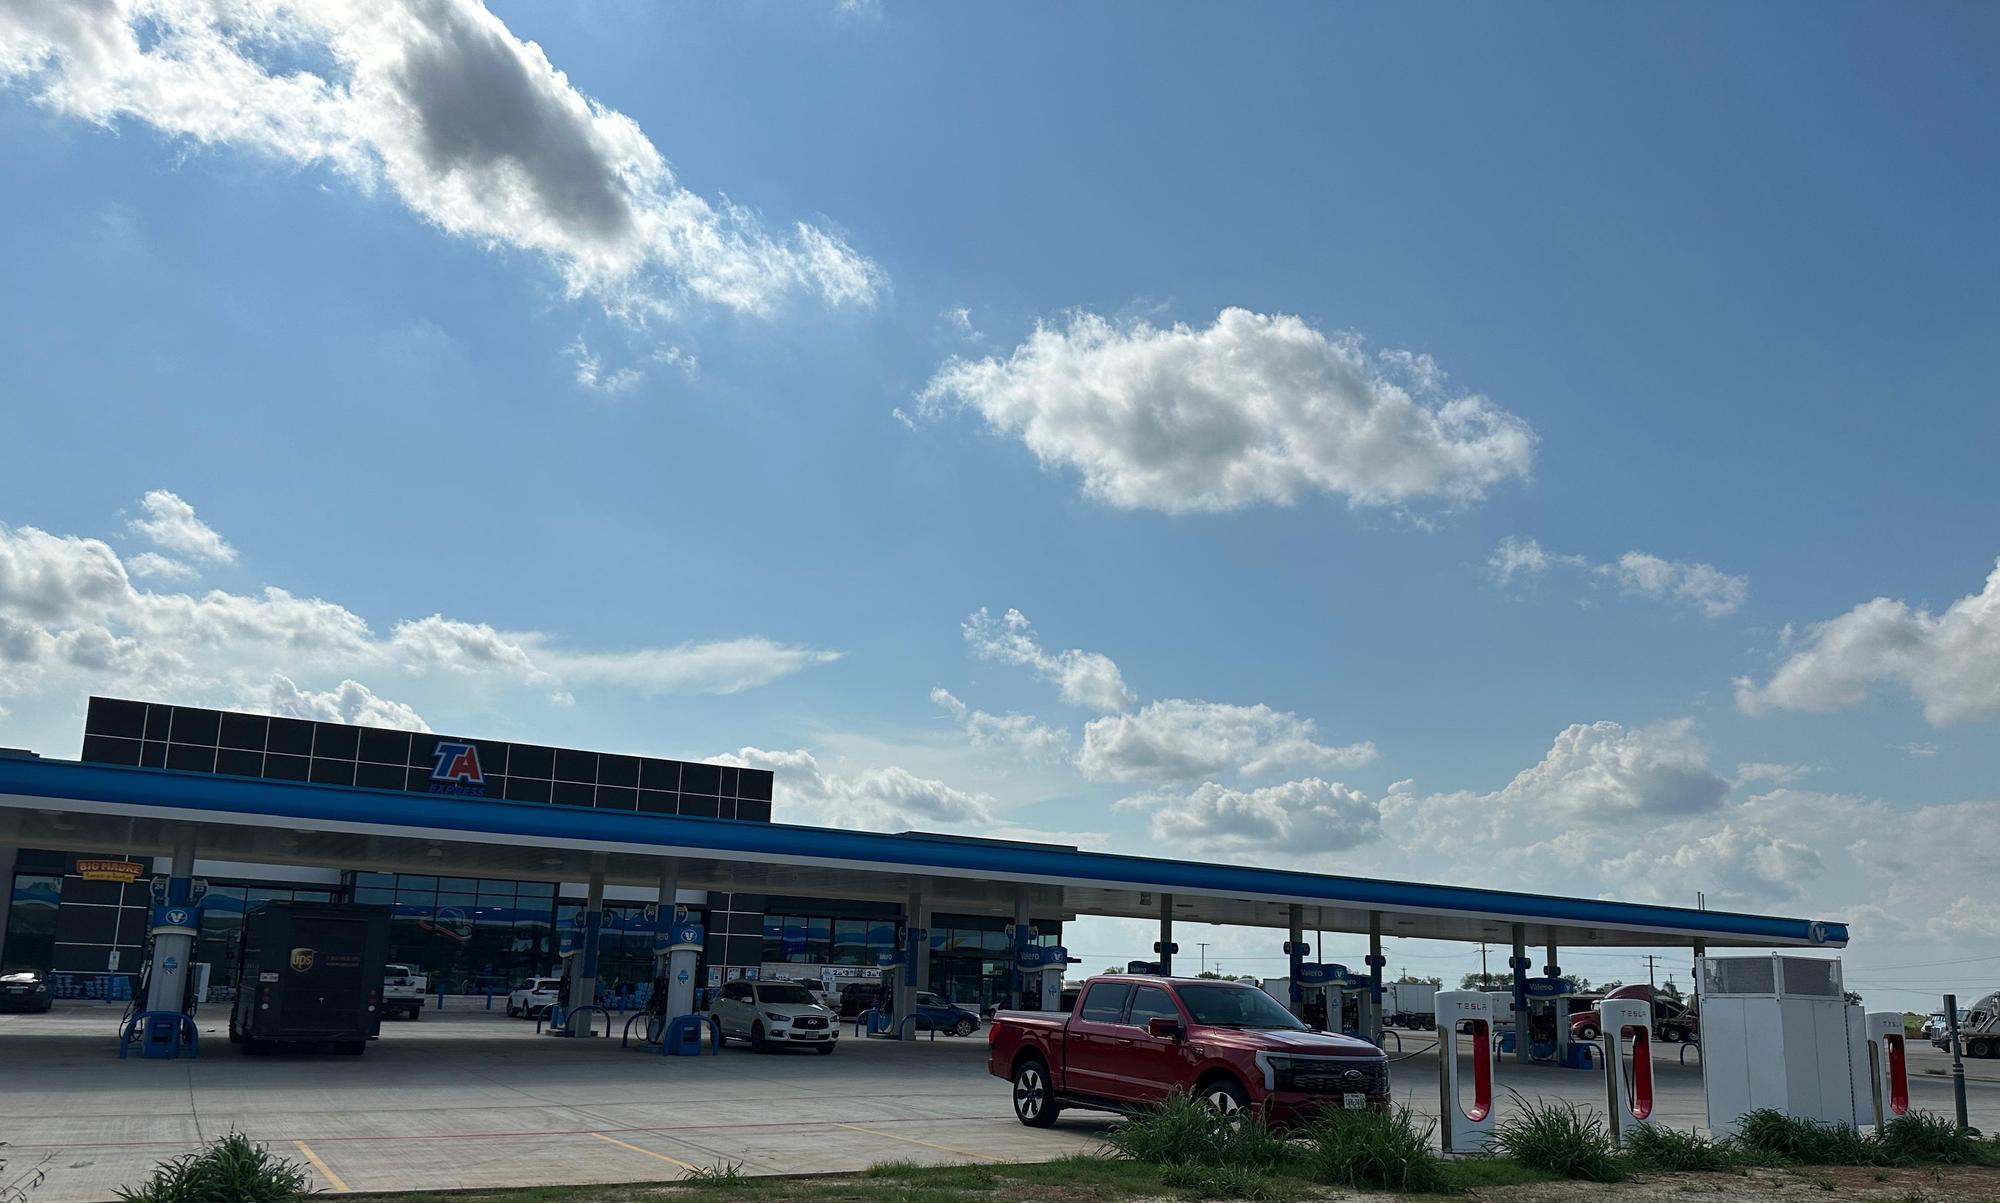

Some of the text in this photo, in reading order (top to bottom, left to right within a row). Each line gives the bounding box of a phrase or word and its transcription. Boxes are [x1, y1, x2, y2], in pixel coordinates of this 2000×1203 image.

[432, 741, 484, 783] TA
[429, 784, 486, 796] EXPRESS
[79, 862, 98, 871] BIG
[1300, 968, 1324, 977] Valero
[1529, 983, 1554, 991] Valero
[1456, 1002, 1487, 1010] TESLA
[1620, 1010, 1646, 1018] TESLA
